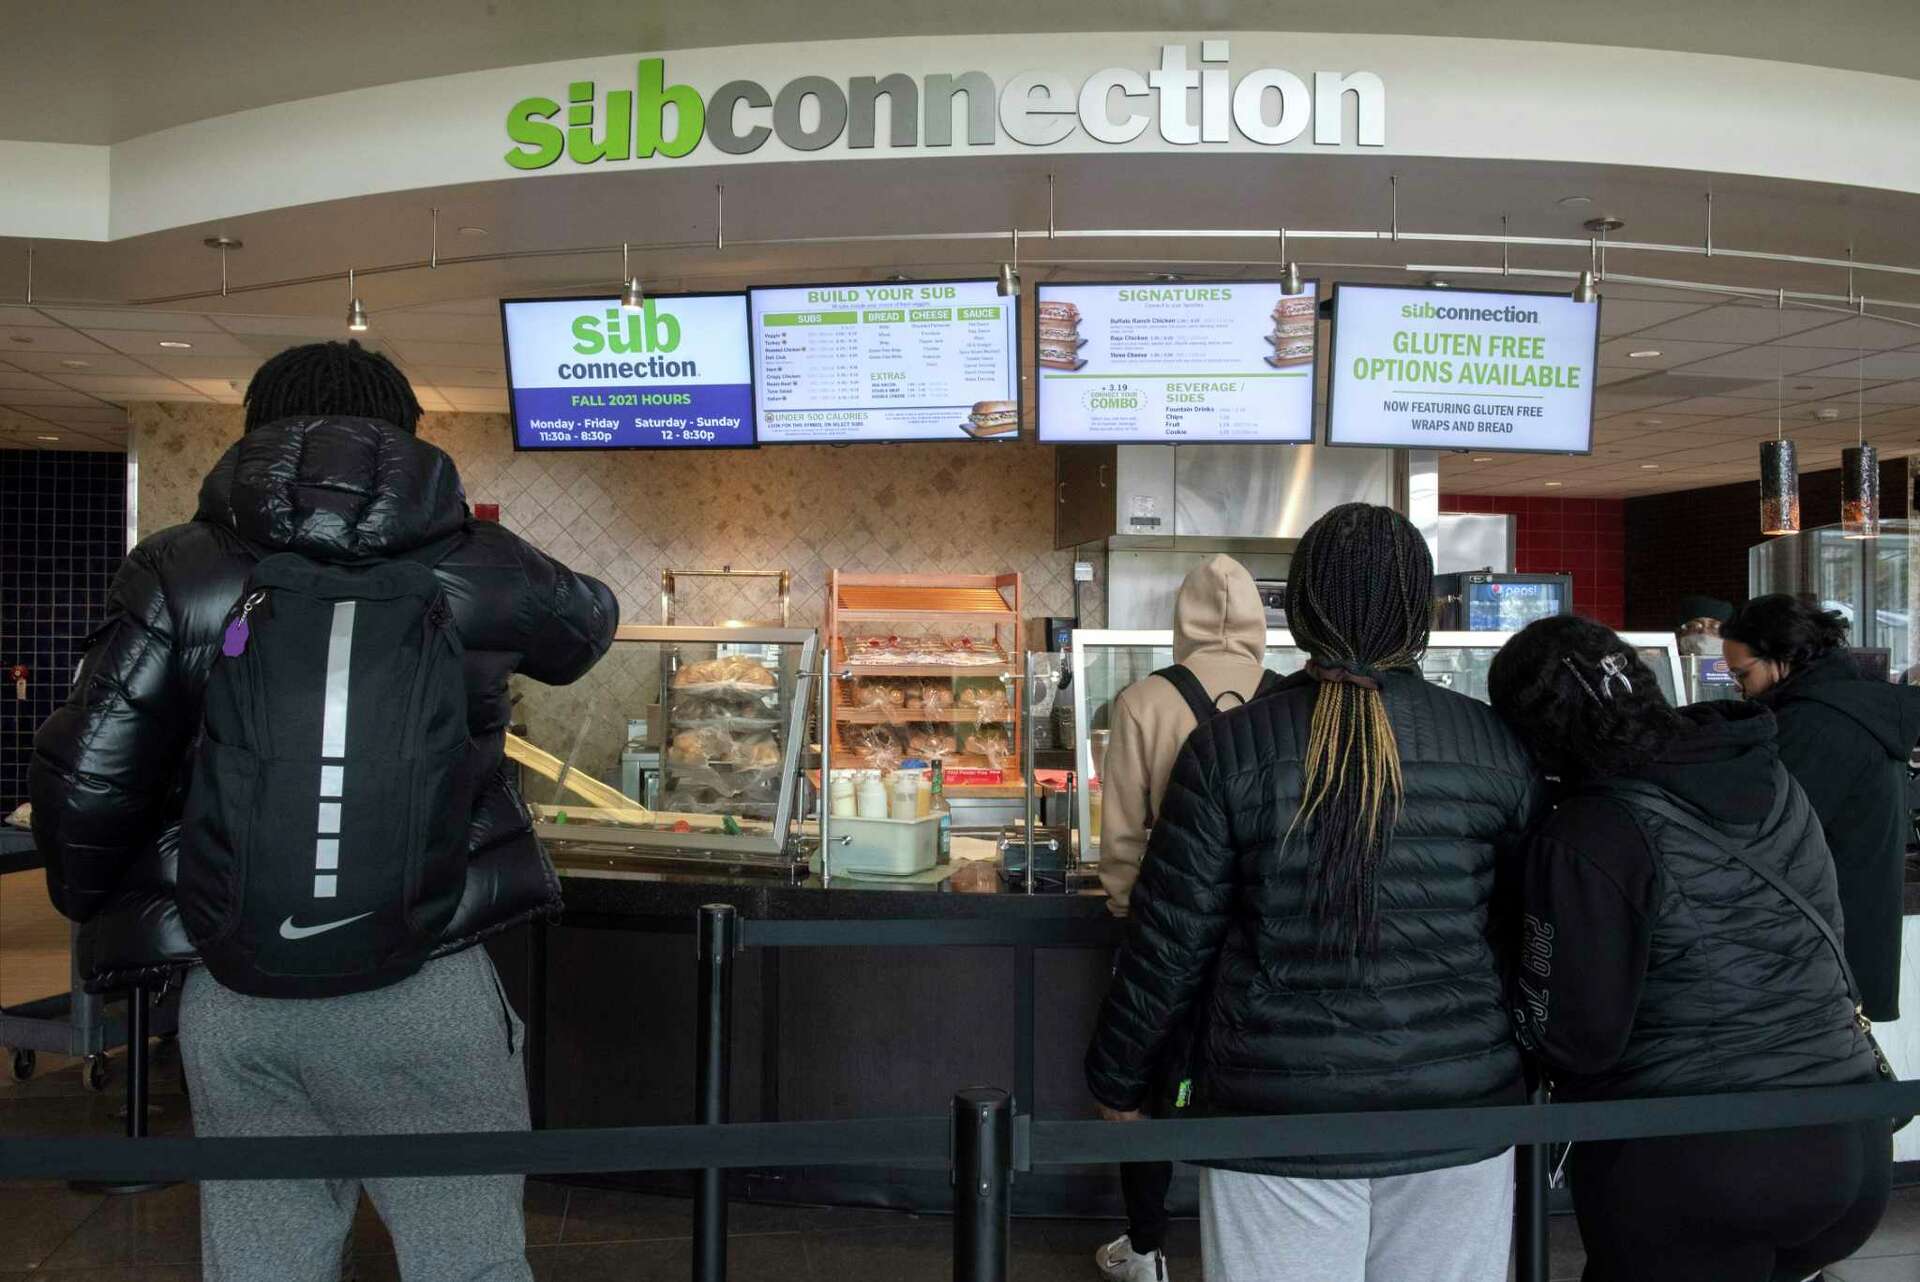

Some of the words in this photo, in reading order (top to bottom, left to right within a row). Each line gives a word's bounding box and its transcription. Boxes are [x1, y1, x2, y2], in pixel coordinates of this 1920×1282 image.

[808, 290, 859, 303] BUILD
[866, 288, 913, 301] YOUR
[920, 287, 956, 299] SUB
[1118, 288, 1233, 302] SIGNATURES
[798, 314, 822, 323] SUBS
[868, 312, 899, 321] BREAD
[912, 311, 948, 319] CHEESE
[963, 309, 993, 318] SAUCE
[571, 298, 681, 355] sub
[1393, 331, 1482, 357] GLUTEN
[1488, 335, 1545, 360] FREE
[557, 355, 697, 379] connection
[871, 372, 906, 381] EXTRAS
[1353, 358, 1453, 384] OPTIONS
[1458, 362, 1581, 389] AVAILABLE
[1166, 382, 1237, 393] BEVERAGE
[571, 395, 605, 407] FALL
[609, 394, 638, 406] 2021
[642, 394, 691, 405] HOURS
[1090, 398, 1138, 409] COMBO
[1166, 393, 1205, 404] SIDES
[1383, 401, 1409, 412] NOW
[1412, 402, 1470, 415] FEATURING
[1473, 404, 1514, 416] GLUTEN
[1517, 406, 1543, 417] FREE
[635, 417, 687, 429] Saturday
[697, 416, 740, 429] Sunday
[776, 413, 804, 421] UNDER
[826, 412, 869, 420] CALORIES
[530, 419, 574, 431] Monday
[584, 418, 620, 430] Friday
[1411, 419, 1449, 431] WRAPS
[1452, 420, 1474, 432] AND
[1477, 422, 1513, 433] BREAD
[540, 432, 571, 441] 11:30a
[580, 431, 612, 442] 8:30p
[661, 430, 673, 440] 12
[682, 430, 715, 442] 8:30p
